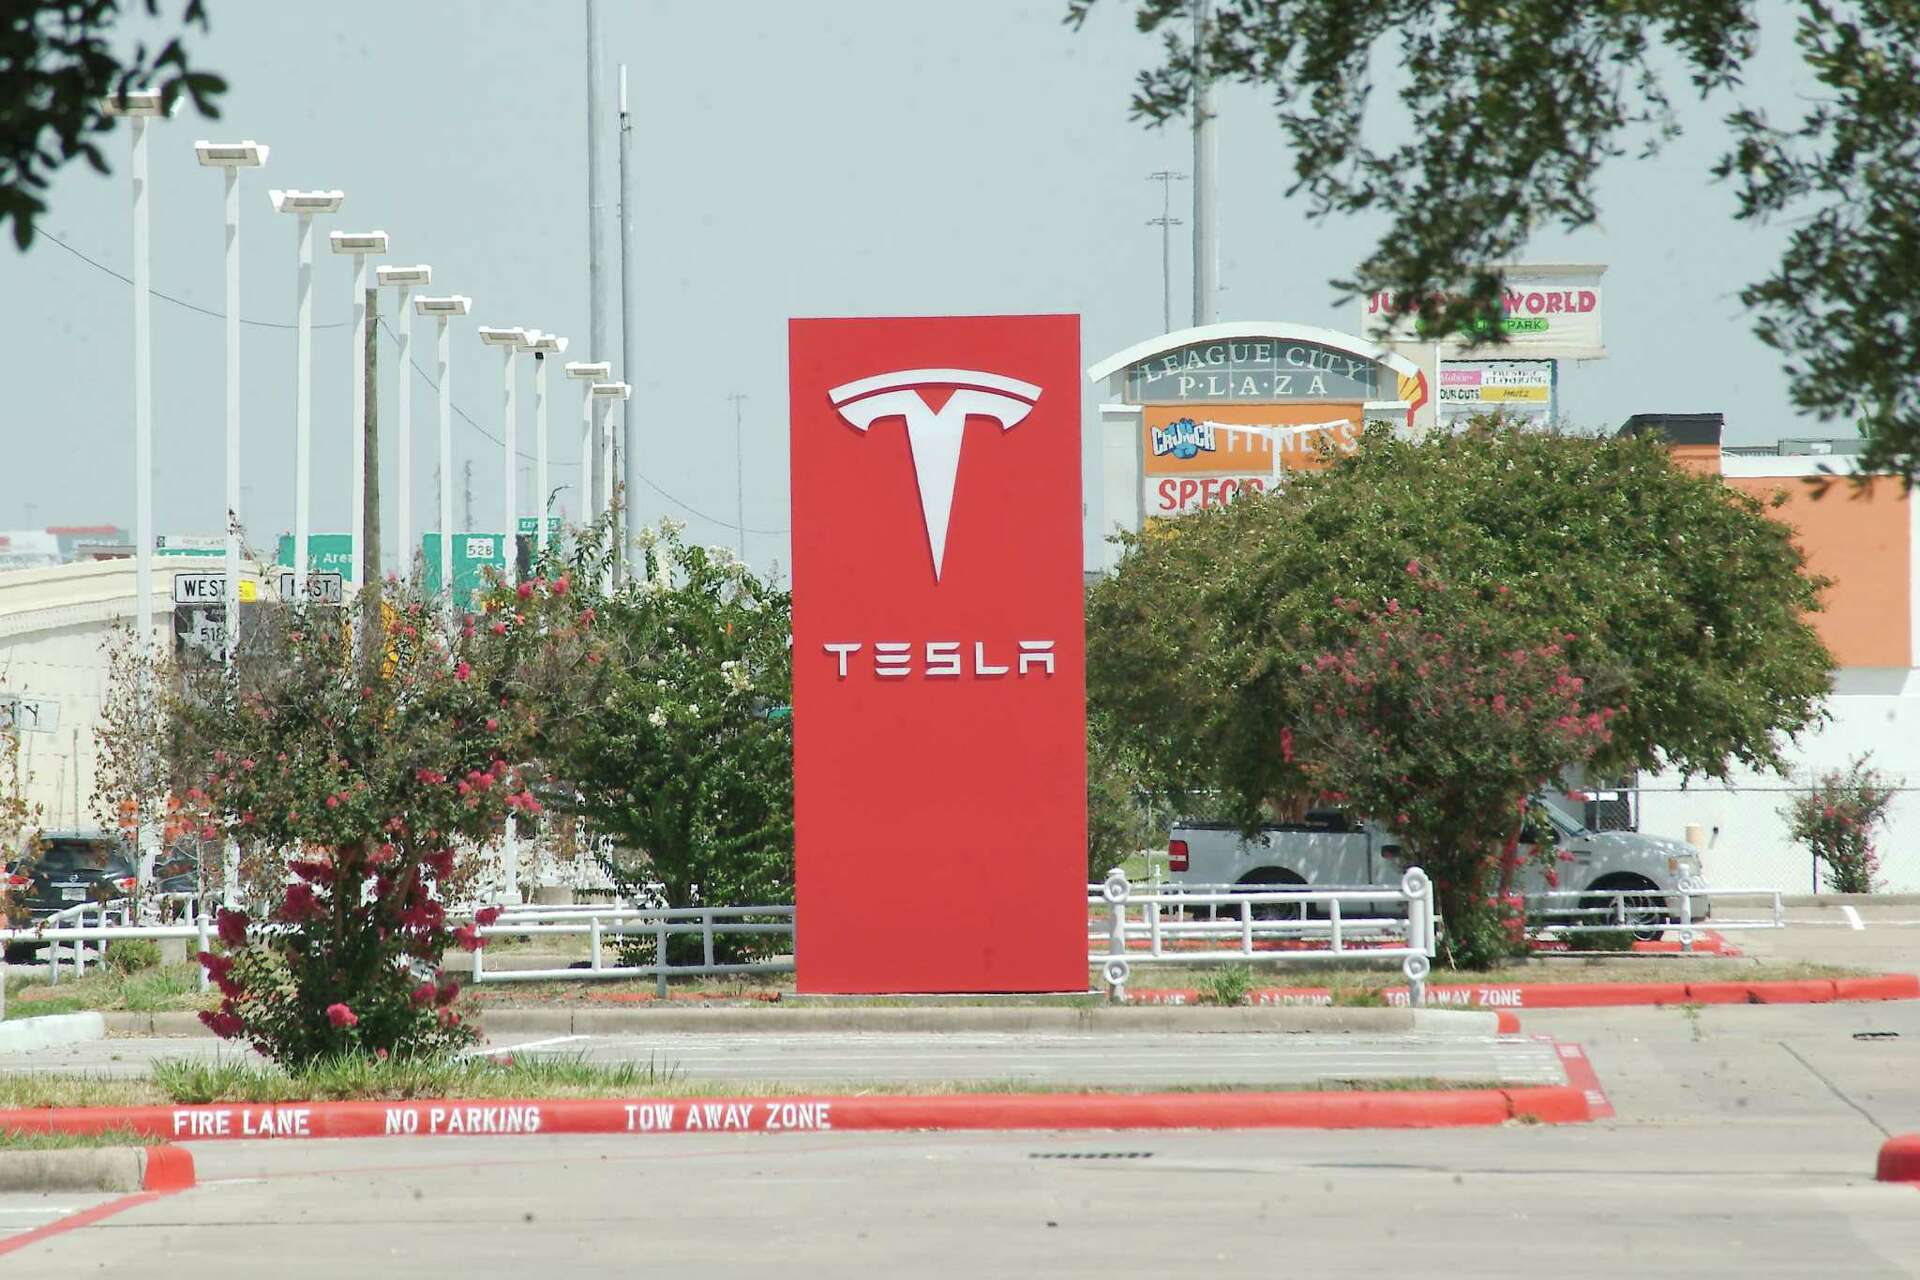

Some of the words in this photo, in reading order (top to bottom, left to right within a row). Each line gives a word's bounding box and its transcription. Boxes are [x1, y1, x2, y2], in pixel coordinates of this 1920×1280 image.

[1499, 290, 1597, 315] WORLD
[1507, 319, 1542, 330] PARK
[1142, 343, 1272, 384] LEAGUE
[1286, 346, 1366, 381] CITY
[1151, 420, 1217, 457] CRUNCH
[1158, 479, 1264, 511] SPEC
[468, 544, 493, 556] 528
[184, 579, 227, 597] WEST
[823, 640, 1055, 676] TESLA
[1427, 990, 1471, 1006] AWAY
[1479, 988, 1523, 1006] ZONE
[173, 1110, 230, 1136] FIRE
[242, 1109, 311, 1136] LANE
[385, 1108, 418, 1134] NO
[430, 1106, 541, 1133] PARKING
[624, 1104, 674, 1130] TOW
[686, 1103, 753, 1130] AWAY
[766, 1103, 832, 1129] ZONE
